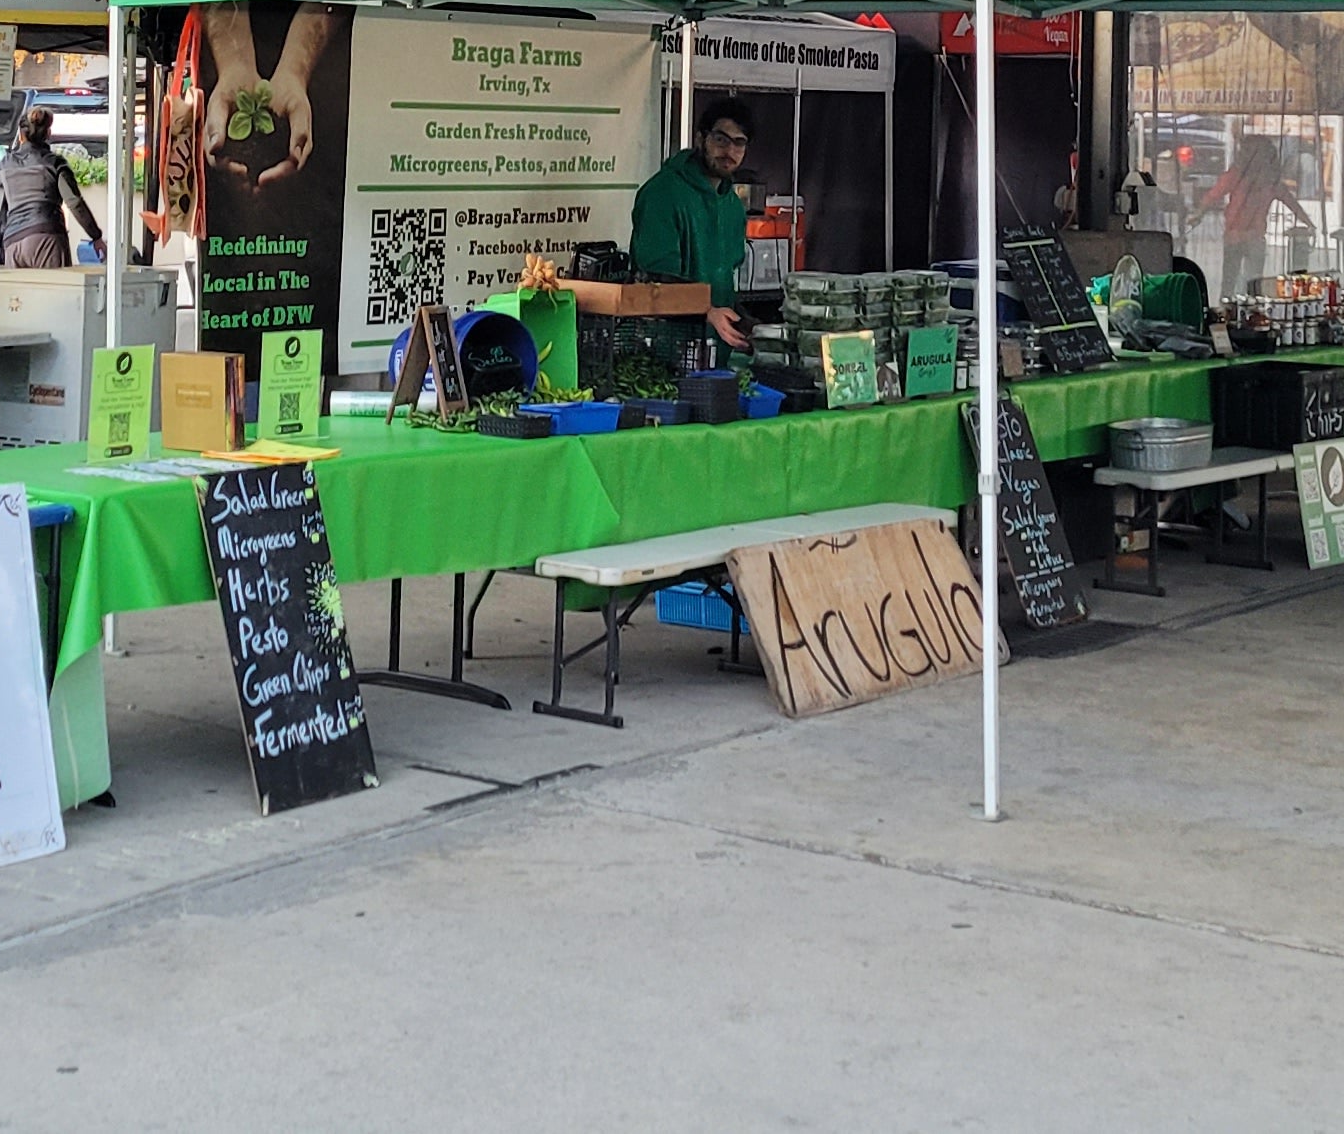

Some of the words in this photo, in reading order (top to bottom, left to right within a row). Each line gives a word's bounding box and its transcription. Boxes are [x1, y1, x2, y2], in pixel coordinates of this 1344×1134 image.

[452, 37, 515, 67] Braga
[520, 41, 582, 67] Farms
[722, 36, 758, 62] Home
[761, 41, 775, 63] of
[776, 41, 795, 64] the
[798, 43, 845, 69] Smoked
[847, 47, 879, 71] Pasta
[479, 74, 530, 97] Irving,
[533, 76, 551, 93] Tx
[425, 121, 482, 140] Garden
[485, 122, 525, 141] Fresh
[528, 124, 591, 145] Produce,
[390, 154, 492, 177] Microgreens,
[495, 155, 547, 177] Pestos,
[549, 157, 576, 173] and
[578, 156, 616, 173] More!
[455, 206, 591, 229] @BragaFarmsDFW
[208, 235, 308, 258] Redefining
[469, 239, 531, 256] Facebook
[533, 242, 544, 253] &
[546, 238, 578, 254] Insta
[203, 271, 254, 293] Local
[257, 272, 277, 291] in
[279, 269, 310, 290] The
[467, 269, 495, 288] Pay
[252, 307, 270, 328] of
[273, 304, 314, 327] DFW
[910, 353, 952, 367] ARUGULA
[211, 473, 268, 524] Salad
[217, 524, 297, 566] Microgreens
[227, 568, 290, 612] Herbs
[239, 616, 288, 659] Pesto
[243, 663, 291, 707] Green
[293, 650, 331, 696] Chips
[254, 699, 348, 758] Fermented
